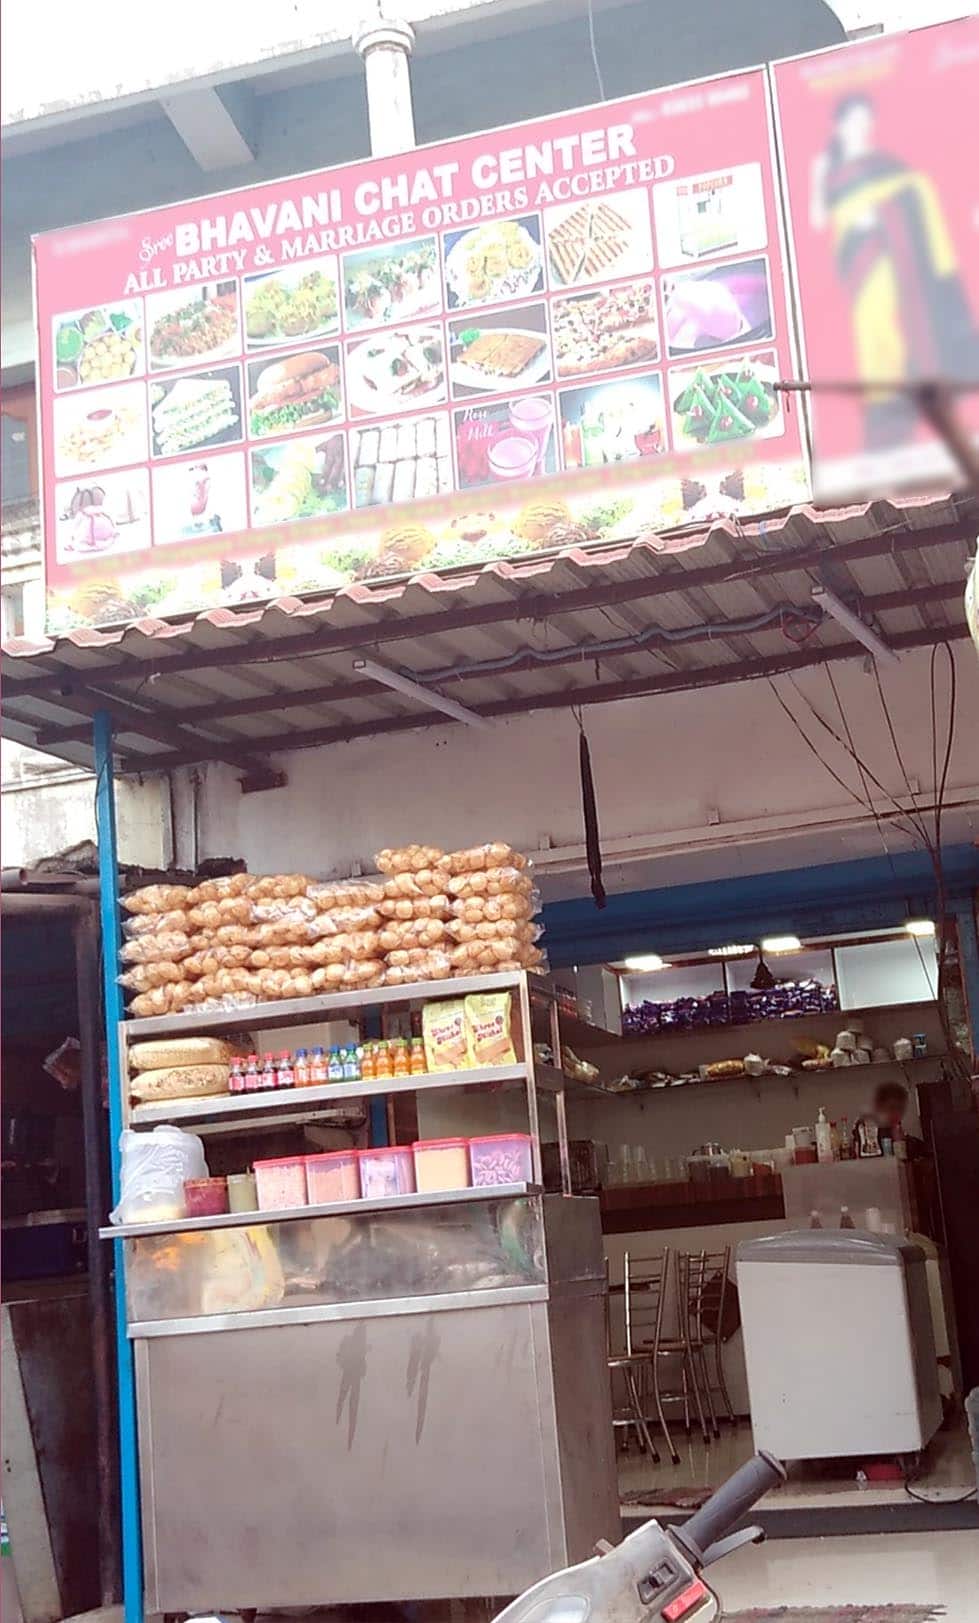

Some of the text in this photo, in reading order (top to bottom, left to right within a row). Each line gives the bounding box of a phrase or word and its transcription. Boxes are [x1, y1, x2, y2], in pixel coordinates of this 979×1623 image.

[123, 268, 168, 295] ALL
[173, 248, 247, 284] PARTY
[254, 245, 275, 265] &
[280, 211, 417, 261] MARRIAGE
[421, 185, 529, 229] ORDERS
[534, 154, 676, 206] ACCEPTED
[175, 188, 343, 257] BHAVANI
[354, 162, 460, 215] CHAT
[471, 124, 637, 189] CENTER
